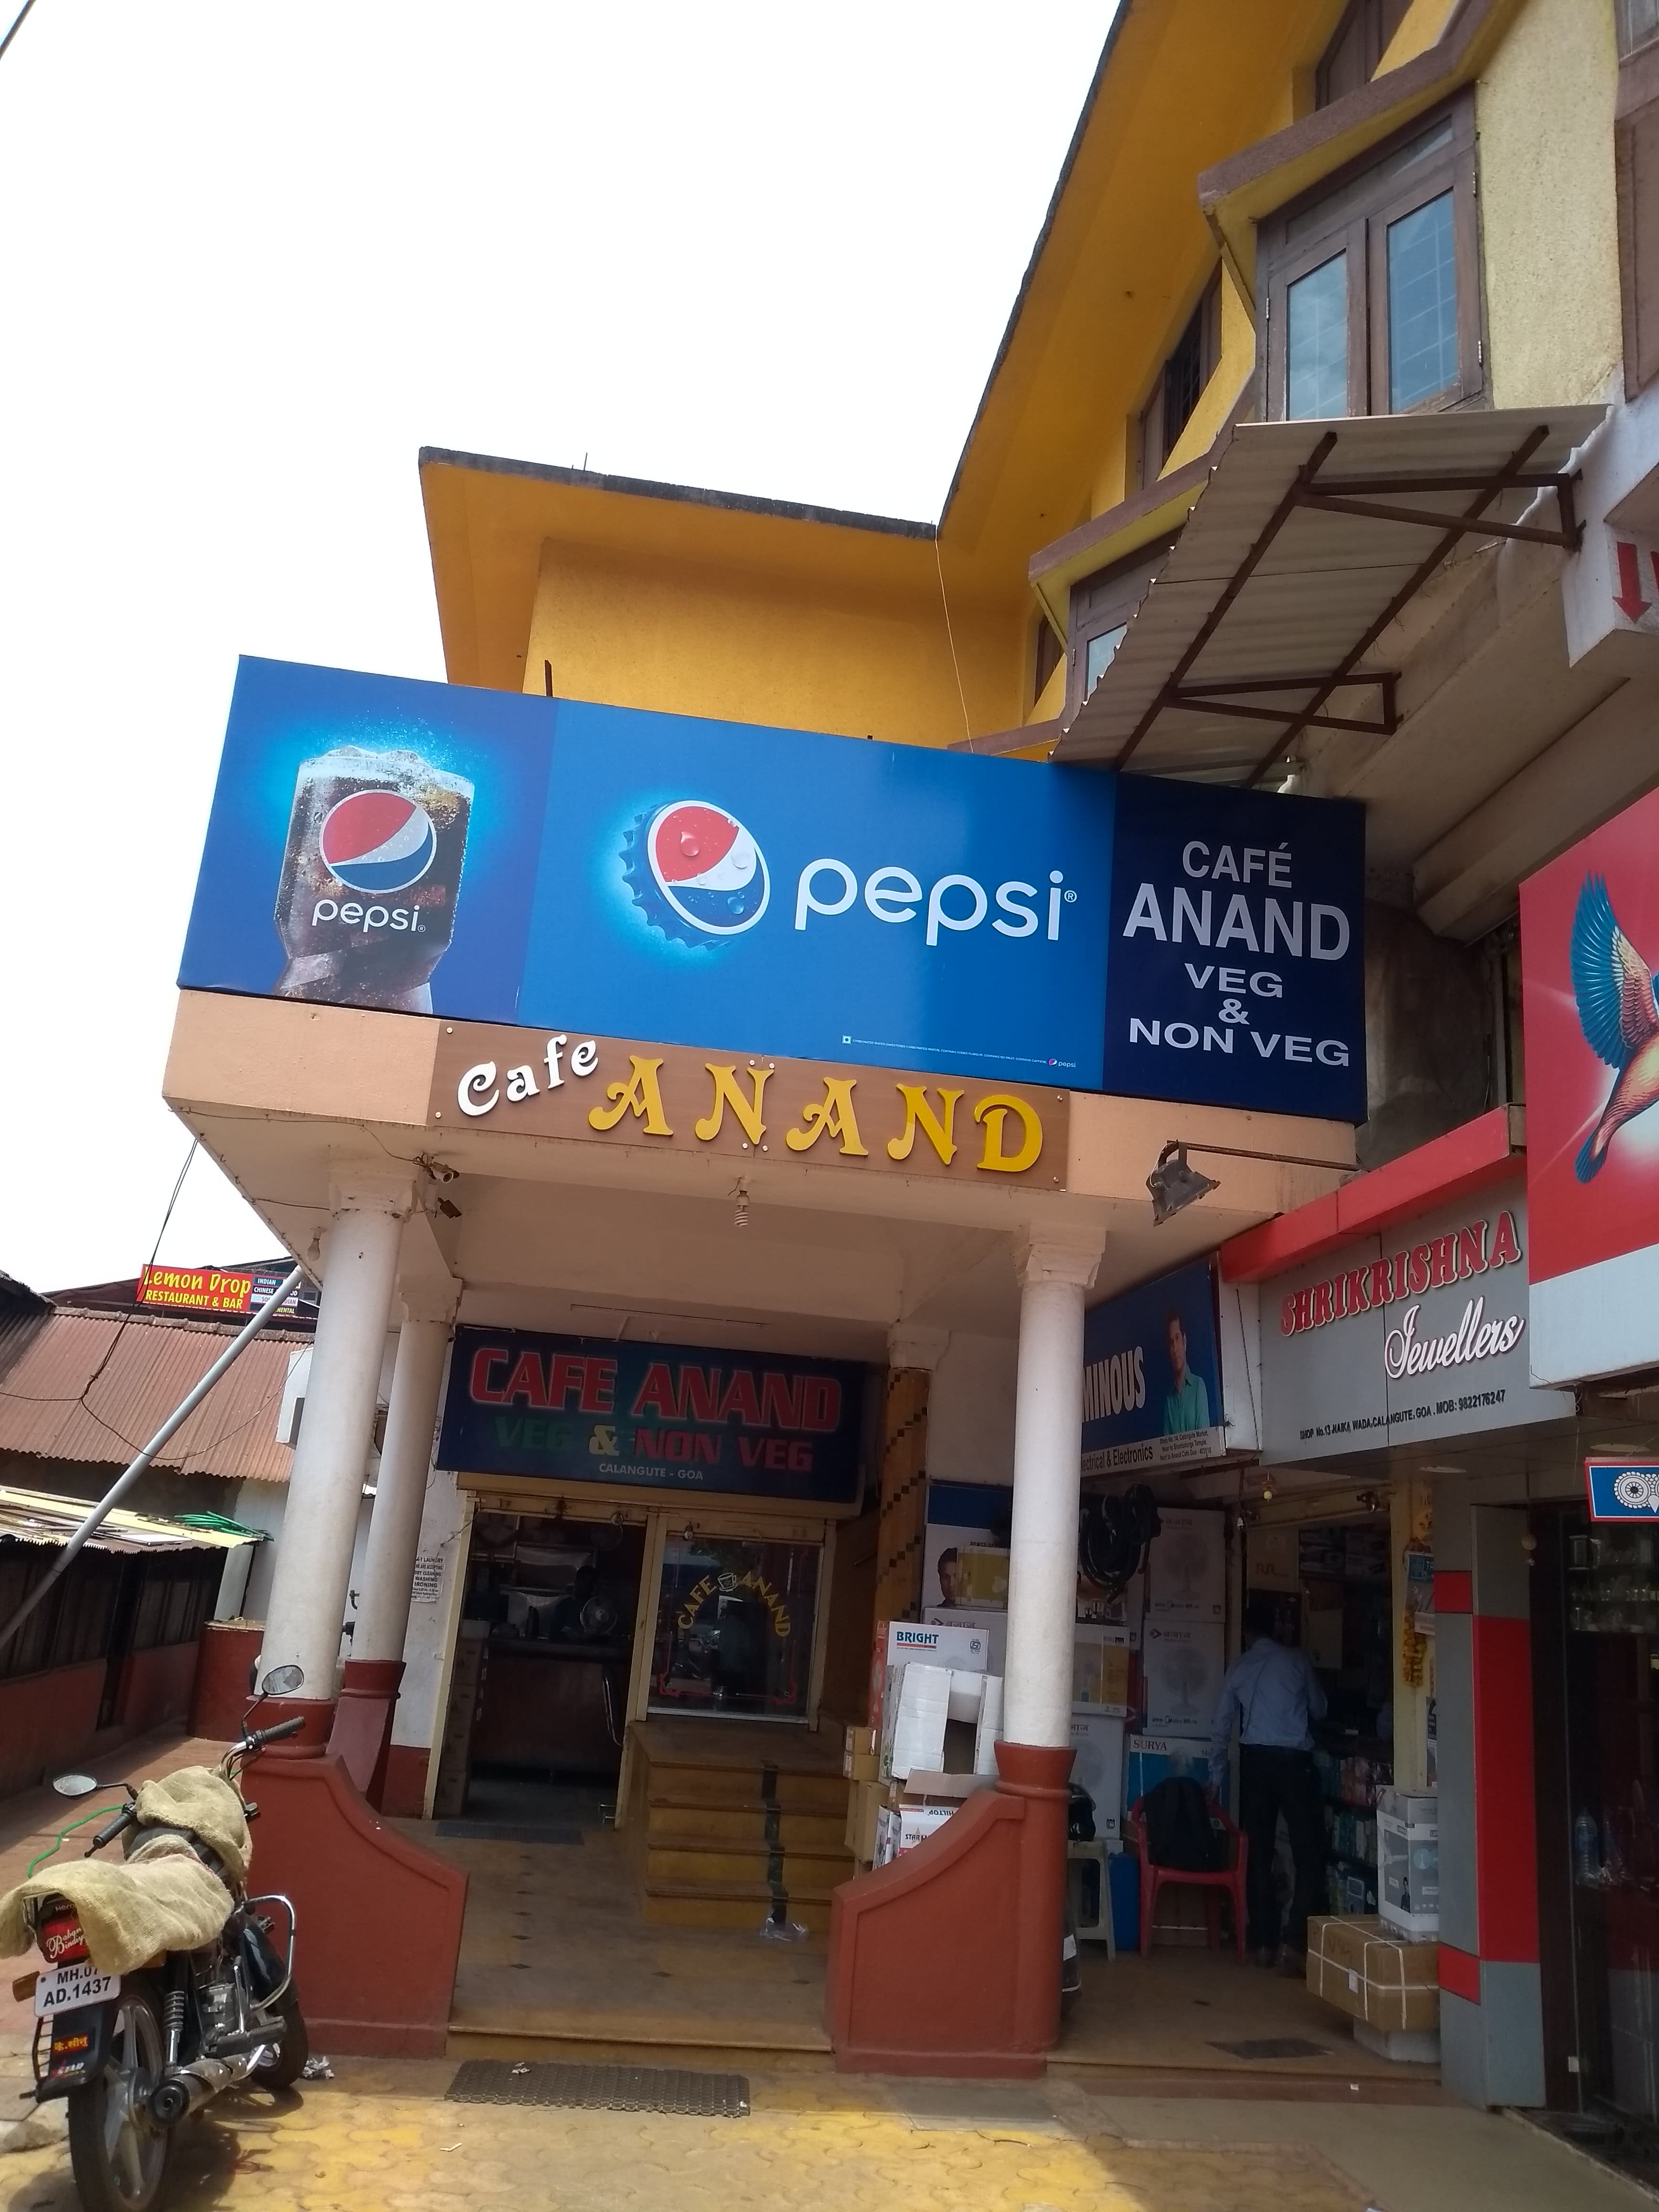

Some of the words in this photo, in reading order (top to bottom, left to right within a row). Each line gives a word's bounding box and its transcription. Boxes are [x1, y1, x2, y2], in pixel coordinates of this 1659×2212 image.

[1182, 841, 1292, 888] CAFÉ
[311, 899, 421, 933] pepsi
[795, 858, 1064, 946] pepsi
[1123, 883, 1350, 961] ANAND
[1184, 963, 1283, 998] VEG
[1218, 999, 1250, 1025] &
[1129, 1018, 1234, 1053] NON
[1250, 1032, 1349, 1066] VEG
[457, 1034, 599, 1117] Cafe
[588, 1055, 1043, 1172] ANAND
[143, 1266, 203, 1290] Lemon
[209, 1274, 251, 1298] Drop
[1280, 1211, 1521, 1337] SHRIKRISHNA
[145, 1290, 209, 1306] RESTAURANT
[212, 1297, 219, 1307] &
[223, 1297, 243, 1309] BAR
[1385, 1297, 1525, 1379] Jewellers
[470, 1348, 617, 1414] CAFE
[631, 1361, 842, 1433] ANAND
[1300, 1428, 1314, 1439] SHOP
[1458, 1389, 1506, 1411] 9822176247
[494, 1415, 573, 1450] VEG
[588, 1425, 619, 1457] &
[634, 1427, 722, 1465] NON
[735, 1436, 813, 1472] VEG
[1106, 1450, 1112, 1468] &
[1113, 1443, 1153, 1466] Electronics
[598, 1463, 667, 1477] CALANGUTE
[678, 1468, 703, 1480] GOA
[678, 1575, 717, 1629] CAFE
[740, 1571, 791, 1637] ANAND
[896, 1631, 939, 1644] BRIGHT
[1133, 1739, 1167, 1751] SURYA
[55, 1904, 75, 1912] Hero
[43, 1976, 111, 2007] AD.1437
